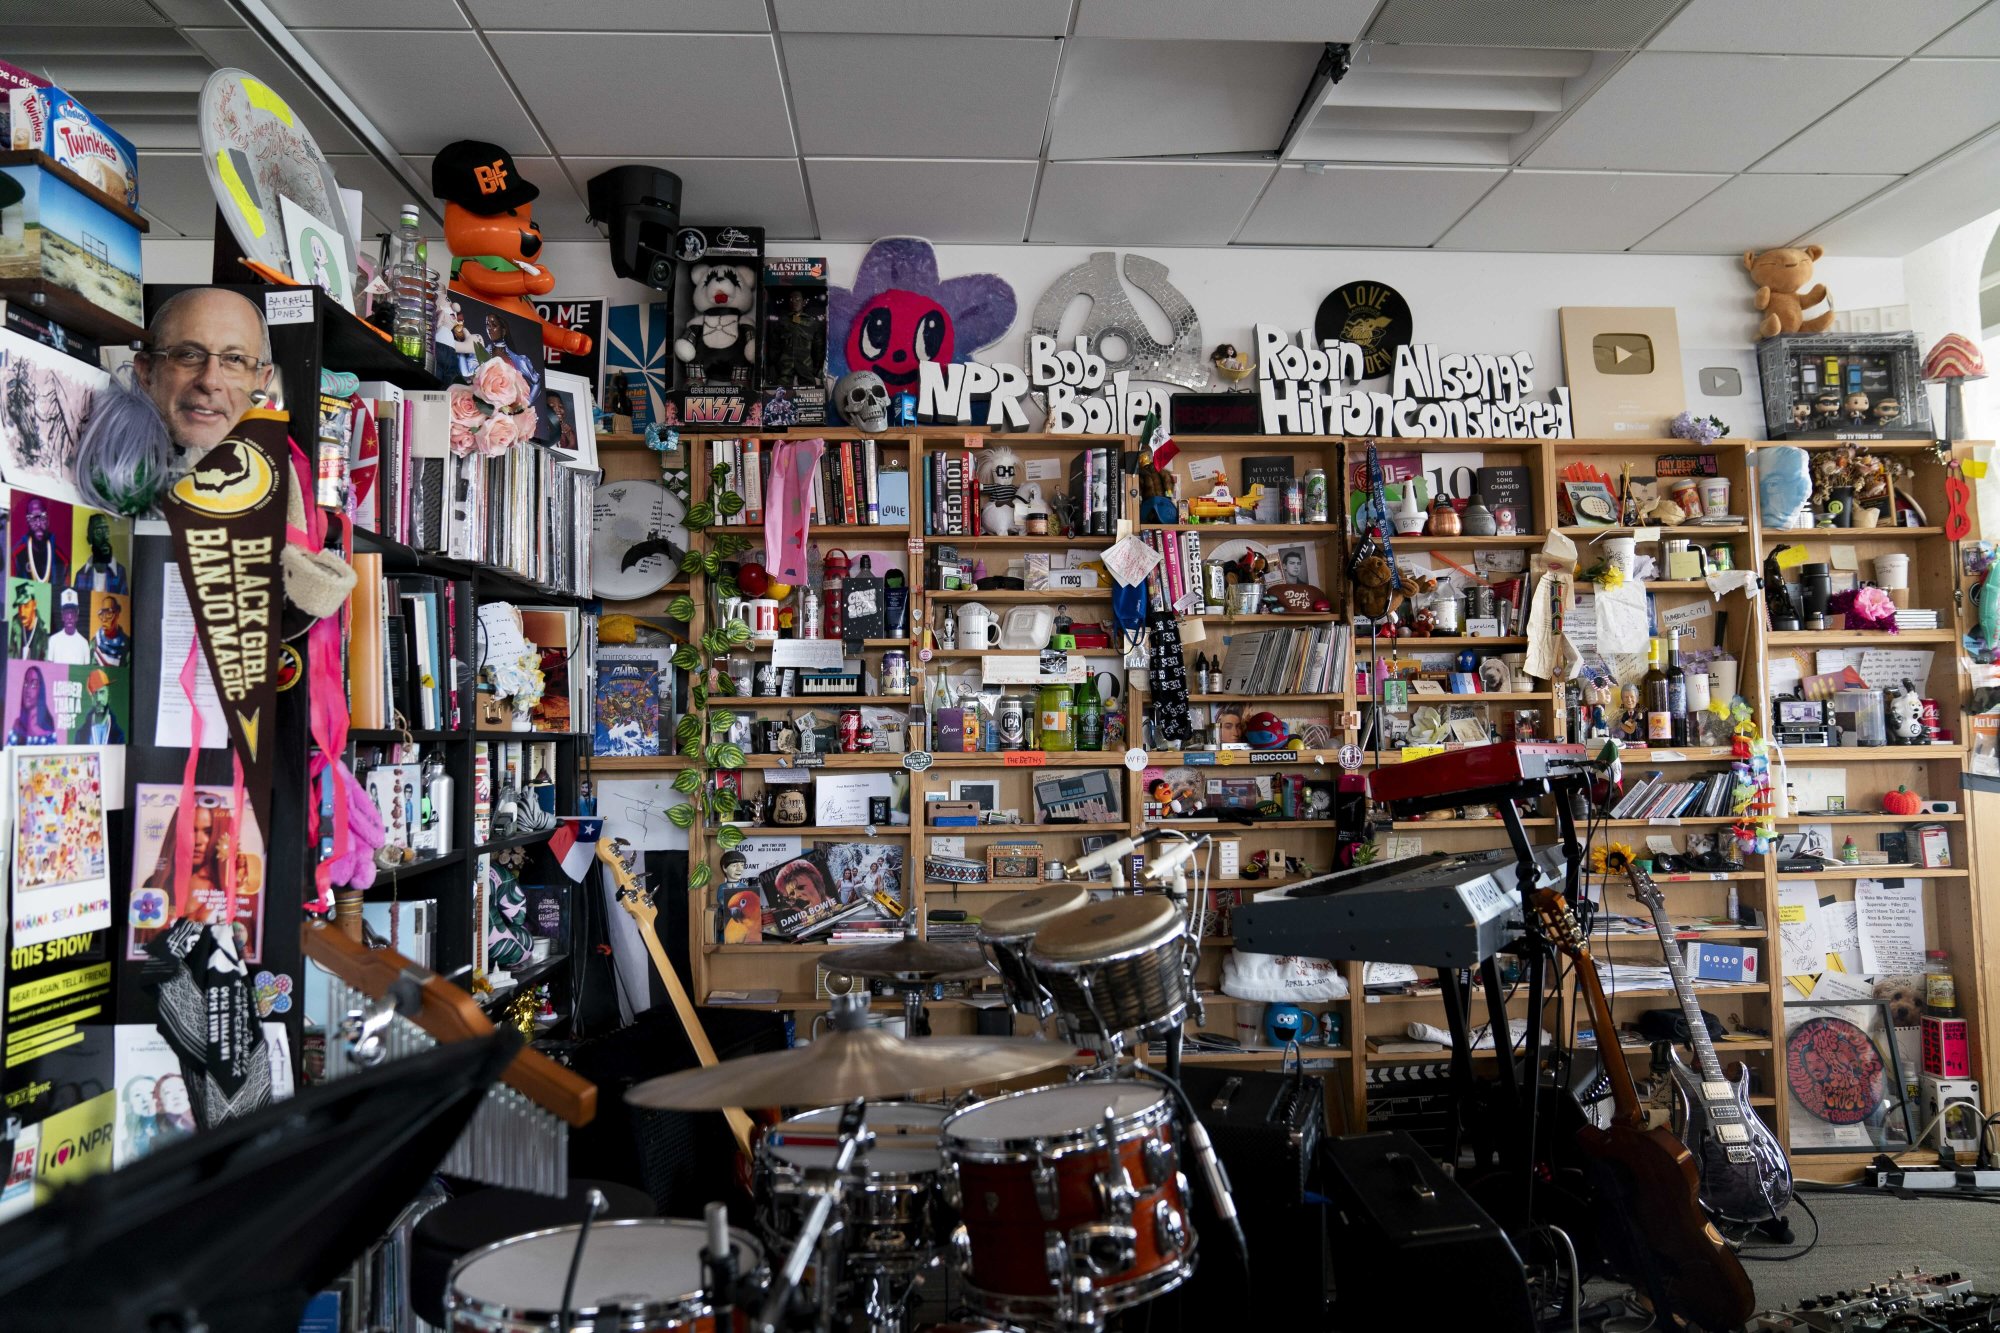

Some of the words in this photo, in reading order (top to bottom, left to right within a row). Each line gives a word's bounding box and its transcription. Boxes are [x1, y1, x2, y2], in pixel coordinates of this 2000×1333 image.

[23, 95, 42, 142] Twinkies
[63, 104, 88, 122] Hostess
[60, 127, 118, 162] Twinkies
[769, 264, 812, 272] MASTER
[1342, 286, 1391, 310] LOVE
[268, 308, 303, 320] JONES
[557, 304, 591, 324] ME
[1031, 335, 1106, 388] Bob
[1257, 323, 1364, 383] Robin
[918, 360, 1030, 430] NPR
[1049, 370, 1171, 434] Boilen
[684, 396, 745, 422] KISS
[1259, 379, 1394, 437] Hilton
[1394, 387, 1575, 438] Considered
[946, 460, 961, 490] LOU
[1658, 460, 1676, 469] TINY
[1676, 460, 1696, 469] DESK
[1658, 469, 1692, 477] CONTEST
[1250, 476, 1289, 484] DEVICES
[1426, 466, 1478, 498] 10
[882, 506, 906, 517] LOUIE
[948, 494, 962, 535] REED
[1167, 534, 1175, 554] GOOD
[185, 526, 237, 618] BANJO
[231, 536, 273, 626] BLACK
[1060, 576, 1082, 587] moog
[1284, 590, 1310, 600] Don't
[1289, 598, 1310, 608] Trip
[208, 624, 246, 702] MAGIC
[240, 628, 267, 690] GIRL
[602, 652, 628, 660] mirror
[611, 666, 641, 679] GWAR
[1004, 719, 1020, 728] IPA
[1019, 756, 1042, 765] BETHS
[1251, 753, 1297, 762] BROCCOLI
[780, 794, 804, 810] Tiny
[778, 810, 804, 822] Desk
[780, 910, 808, 927] DAVID
[809, 898, 838, 915] BOWIE
[78, 1122, 113, 1157] NPR
